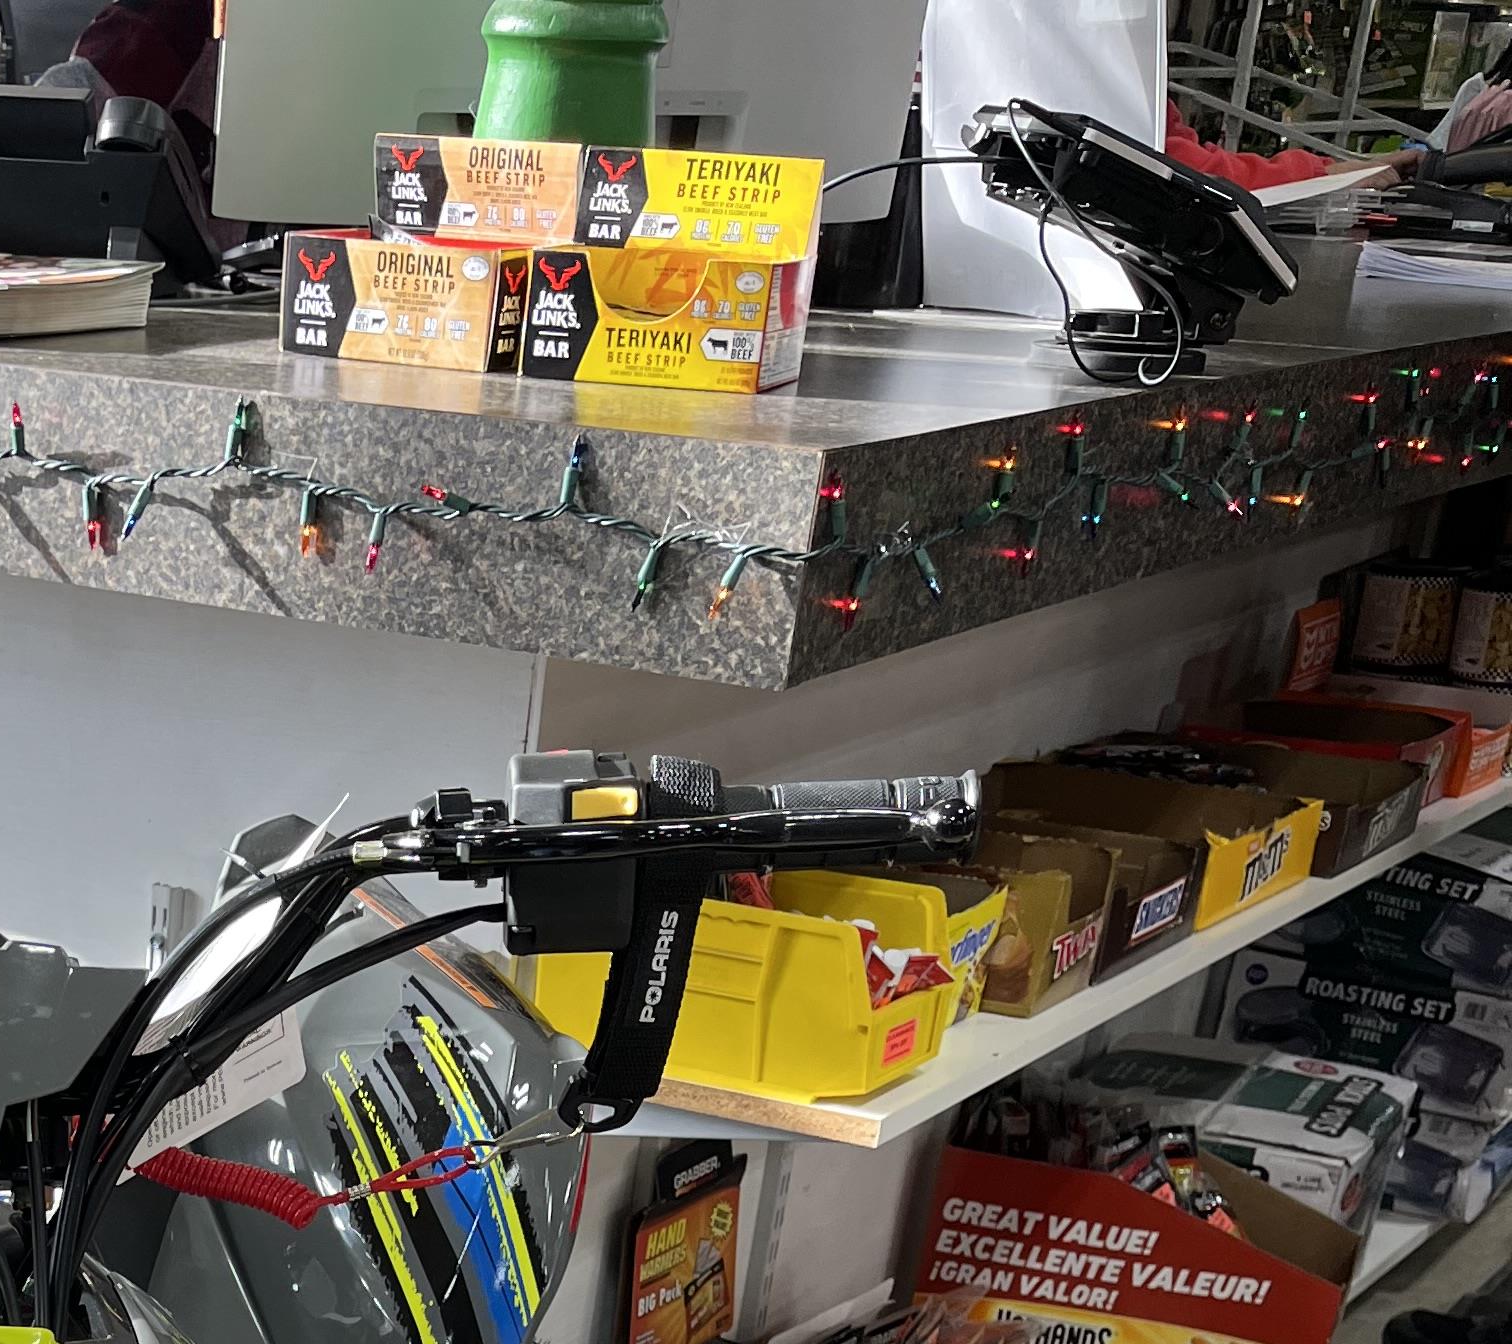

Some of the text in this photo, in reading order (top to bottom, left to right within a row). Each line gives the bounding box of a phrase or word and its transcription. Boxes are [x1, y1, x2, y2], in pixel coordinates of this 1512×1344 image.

[469, 146, 544, 172] ORIGINAL
[392, 170, 421, 187] JACK
[467, 170, 546, 188] BEEF STRIP
[686, 158, 781, 187] TERIYAKI
[593, 181, 629, 198] JACK
[677, 183, 781, 205] BEEF STRIP
[395, 210, 423, 226] BAR
[588, 223, 621, 240] BAR
[377, 250, 454, 279] ORIGINAL
[296, 281, 331, 300] JACK
[374, 275, 456, 294] BEEF STRIP
[501, 295, 521, 311] JACK
[535, 289, 575, 311] JACK
[295, 327, 328, 347] BAR
[497, 337, 515, 354] BAR
[606, 327, 692, 354] TERIYAKI
[532, 339, 570, 359] BAR
[607, 351, 687, 368] BEEF STRIP
[730, 349, 753, 360] BEEF
[1386, 867, 1480, 901] TING SET
[1366, 890, 1422, 912] STAINLESS
[1375, 904, 1407, 921] STEEL
[639, 910, 679, 1023] POLARIS
[1305, 977, 1452, 1021] ROASTING SET
[1342, 1012, 1399, 1035] STAINLESS
[1350, 1027, 1383, 1044] STEEL
[674, 1155, 719, 1190] GRABBER
[942, 1197, 1160, 1256] GREAT VALUE!
[646, 1218, 687, 1260] HAND
[640, 1247, 687, 1282] WARMERS
[934, 1228, 1272, 1305] EXCELLENTE VALEUR!
[929, 1260, 1119, 1312] ¡GRAN VALOR!
[638, 1279, 682, 1318] BIG Pack
